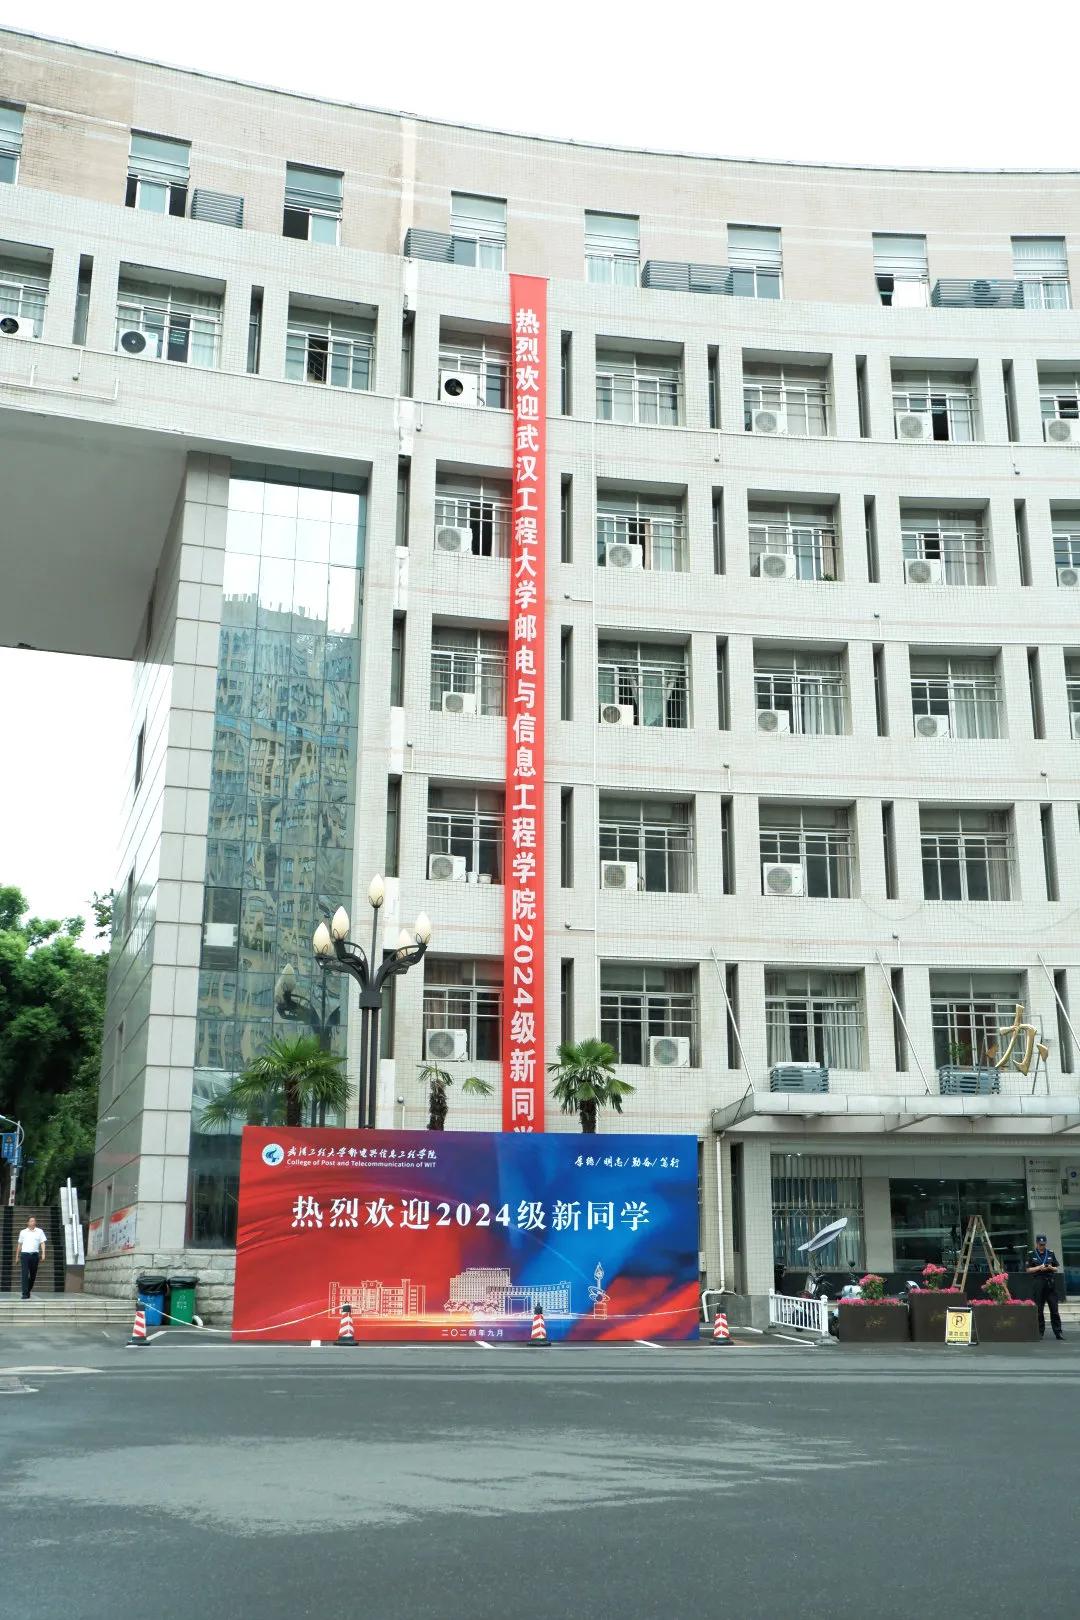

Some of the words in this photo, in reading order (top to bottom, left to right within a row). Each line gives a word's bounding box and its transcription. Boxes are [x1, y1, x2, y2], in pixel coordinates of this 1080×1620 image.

[511, 307, 541, 1133] 热烈欢迎武汉工程大学邮电与信息工程学院2024级新同
[286, 1159, 311, 1167] College
[312, 1159, 320, 1167] of
[321, 1159, 336, 1167] Post
[351, 1160, 415, 1168] Telecommunication
[291, 1195, 650, 1231] 热烈欢迎2024级新同学
